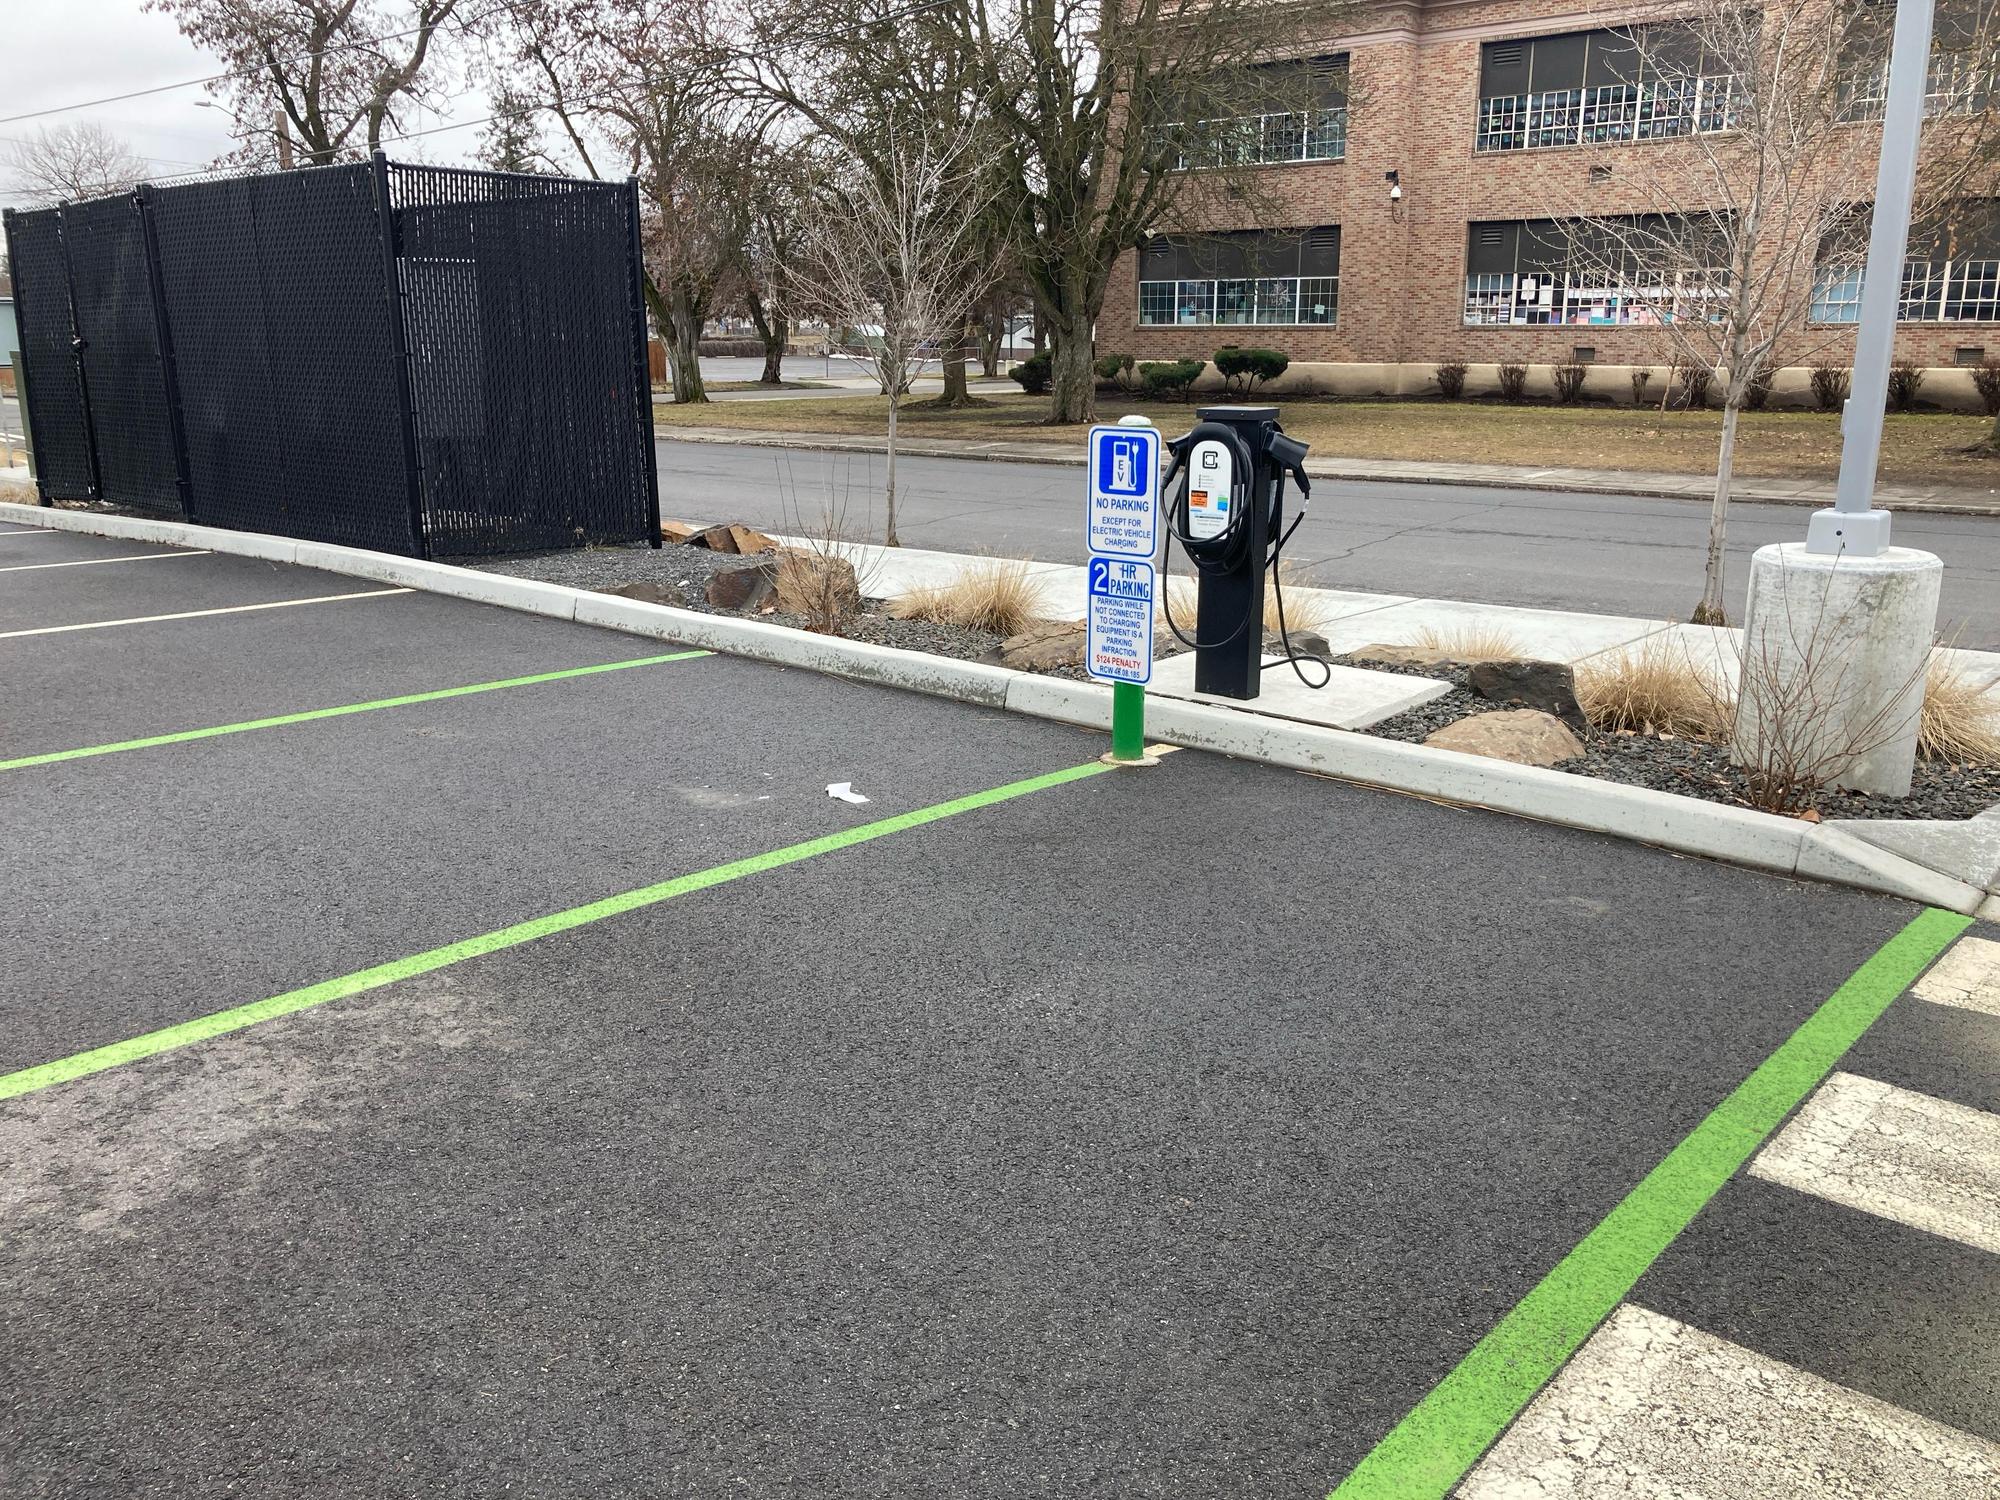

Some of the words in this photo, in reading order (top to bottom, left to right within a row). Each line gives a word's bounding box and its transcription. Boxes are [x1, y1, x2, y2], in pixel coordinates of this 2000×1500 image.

[1096, 497, 1108, 509] NO
[1111, 499, 1149, 512] PARKING
[1102, 516, 1126, 526] EXCEPT
[1128, 519, 1141, 527] FOR
[1092, 526, 1122, 537] ELECTRIC
[1124, 528, 1151, 539] VEHICLE
[1104, 538, 1137, 548] CHARGING
[1094, 562, 1108, 592] 2
[1121, 564, 1136, 580] HR
[1110, 579, 1149, 598] PARKING
[1097, 597, 1123, 607] PARKING
[1125, 601, 1143, 610] WHILE
[1095, 606, 1107, 614] NOT
[1109, 608, 1145, 620] CONNECTED
[1100, 616, 1108, 624] TO
[1109, 618, 1141, 629] CHARGING
[1096, 625, 1130, 636] EQUIPMENT
[1132, 630, 1137, 638] IS
[1106, 637, 1132, 647] PARKING
[1102, 644, 1137, 657] INFRACTION
[1096, 654, 1110, 664] $124
[1112, 656, 1141, 669] PENALTY
[1100, 665, 1113, 674] RCW
